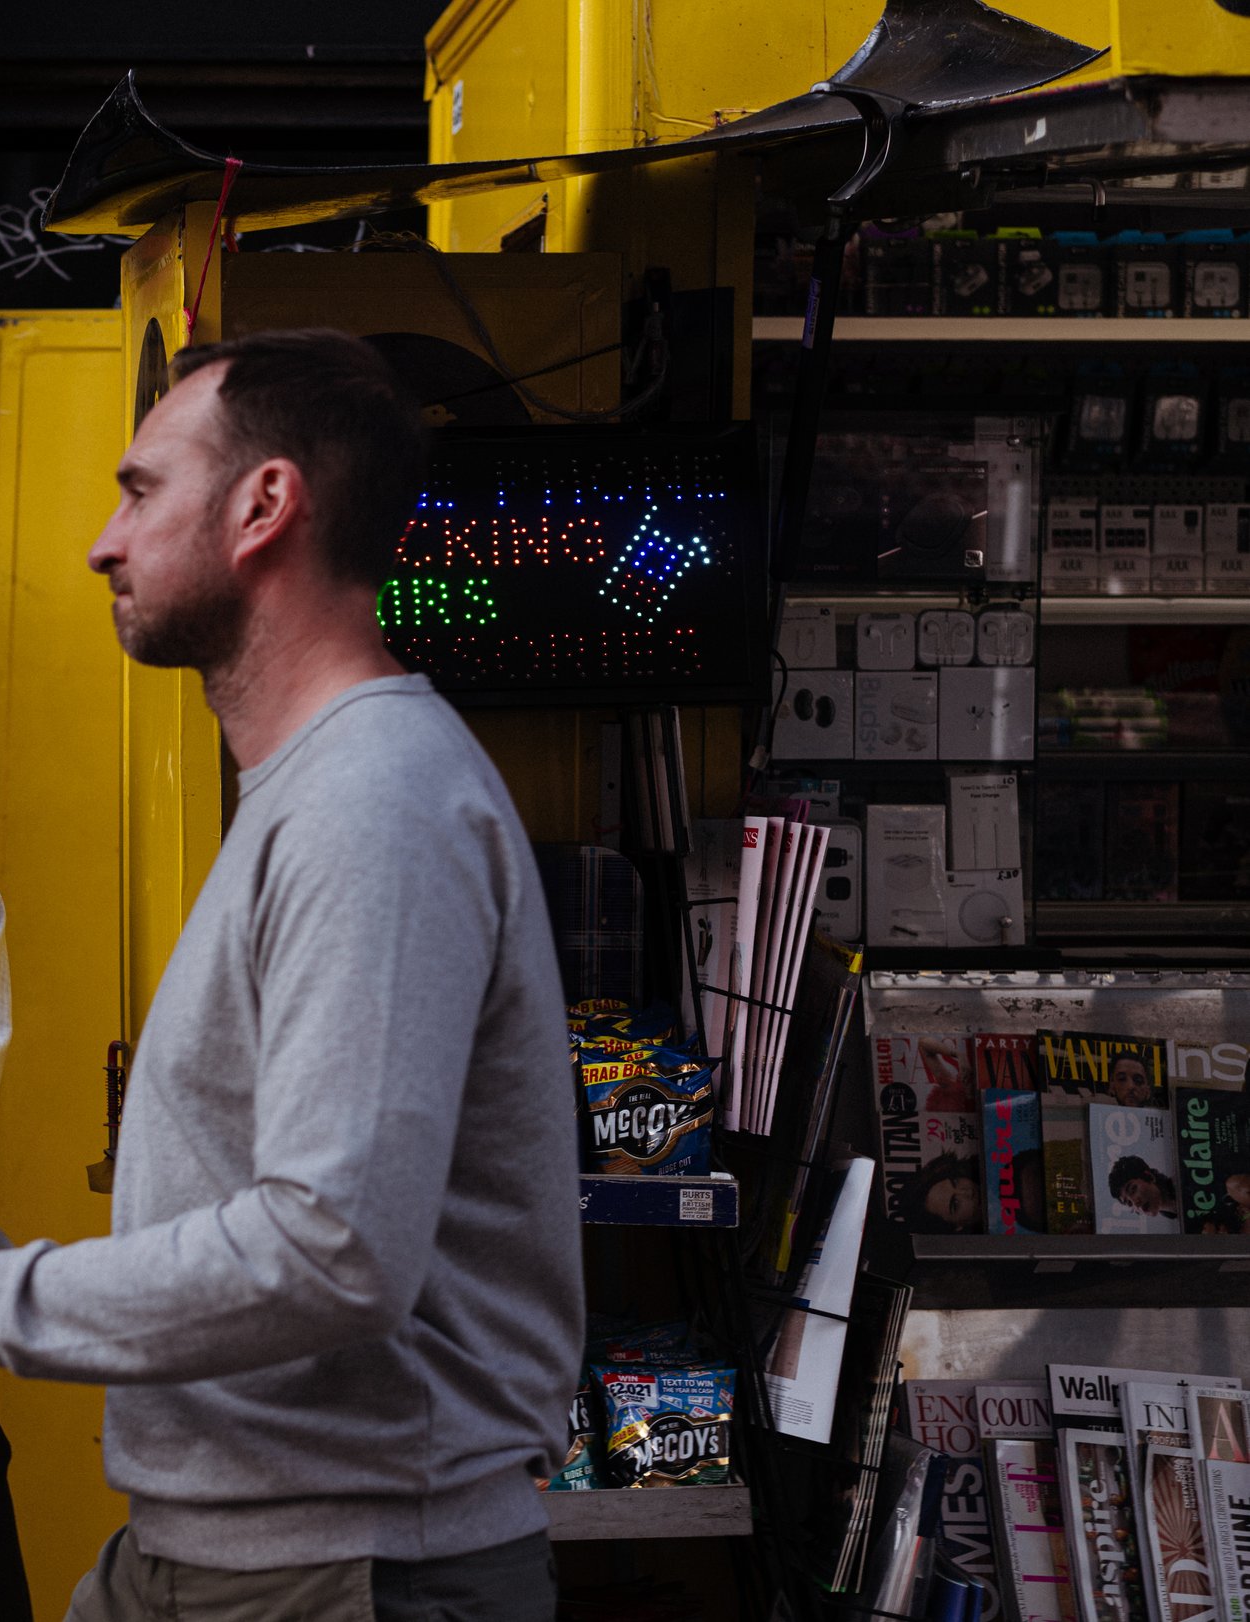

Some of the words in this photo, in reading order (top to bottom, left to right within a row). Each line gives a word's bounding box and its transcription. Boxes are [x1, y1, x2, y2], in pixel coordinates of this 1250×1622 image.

[975, 1037, 1032, 1049] PARTY
[876, 1038, 893, 1084] HELLO!
[582, 1065, 619, 1085] GRAB
[926, 1119, 945, 1142] 29
[953, 1129, 964, 1144] get
[1181, 1097, 1216, 1188] claire
[682, 1190, 711, 1199] BURTS
[617, 1374, 639, 1383] WIN
[662, 1378, 683, 1387] TEXT
[683, 1379, 694, 1387] TO
[695, 1379, 714, 1388] WIN
[1211, 1469, 1228, 1520] CORPORATIONS
